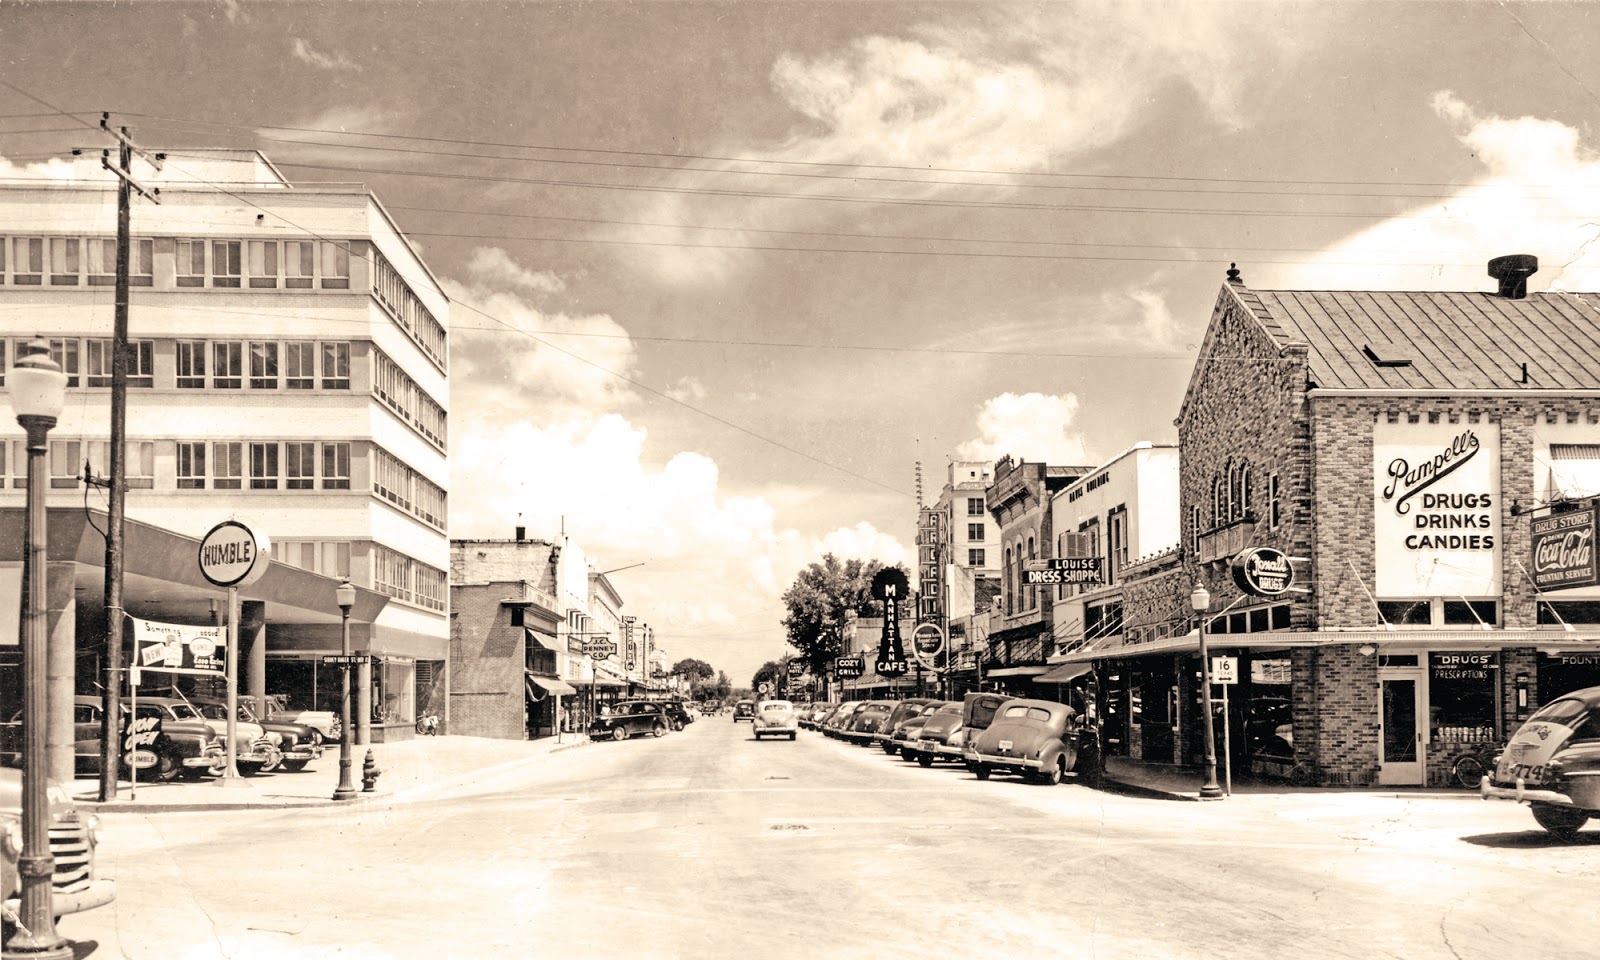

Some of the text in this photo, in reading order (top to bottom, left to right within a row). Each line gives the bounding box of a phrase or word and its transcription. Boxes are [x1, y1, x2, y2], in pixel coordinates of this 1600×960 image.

[1383, 429, 1480, 499] Pampell's
[1086, 472, 1109, 493] BUILDING
[1423, 493, 1492, 509] DRUGS
[1415, 514, 1491, 529] DRINKS
[1535, 514, 1589, 533] DRUG STORE
[1405, 534, 1494, 550] CANDIES
[1535, 528, 1592, 572] Coca-Cola
[203, 540, 251, 567] HUMBLE
[1055, 560, 1095, 569] LOUISE
[1028, 570, 1101, 583] DRESS SHOPPE
[1258, 576, 1285, 590] DRUGS
[1536, 567, 1592, 583] FOUNTAIN SERVICE
[884, 584, 897, 661] MANHATTAN
[878, 662, 905, 671] CAFE
[1219, 660, 1230, 670] 16
[1442, 656, 1488, 664] DRUGS
[1435, 669, 1488, 679] PRESCRIPTIONS
